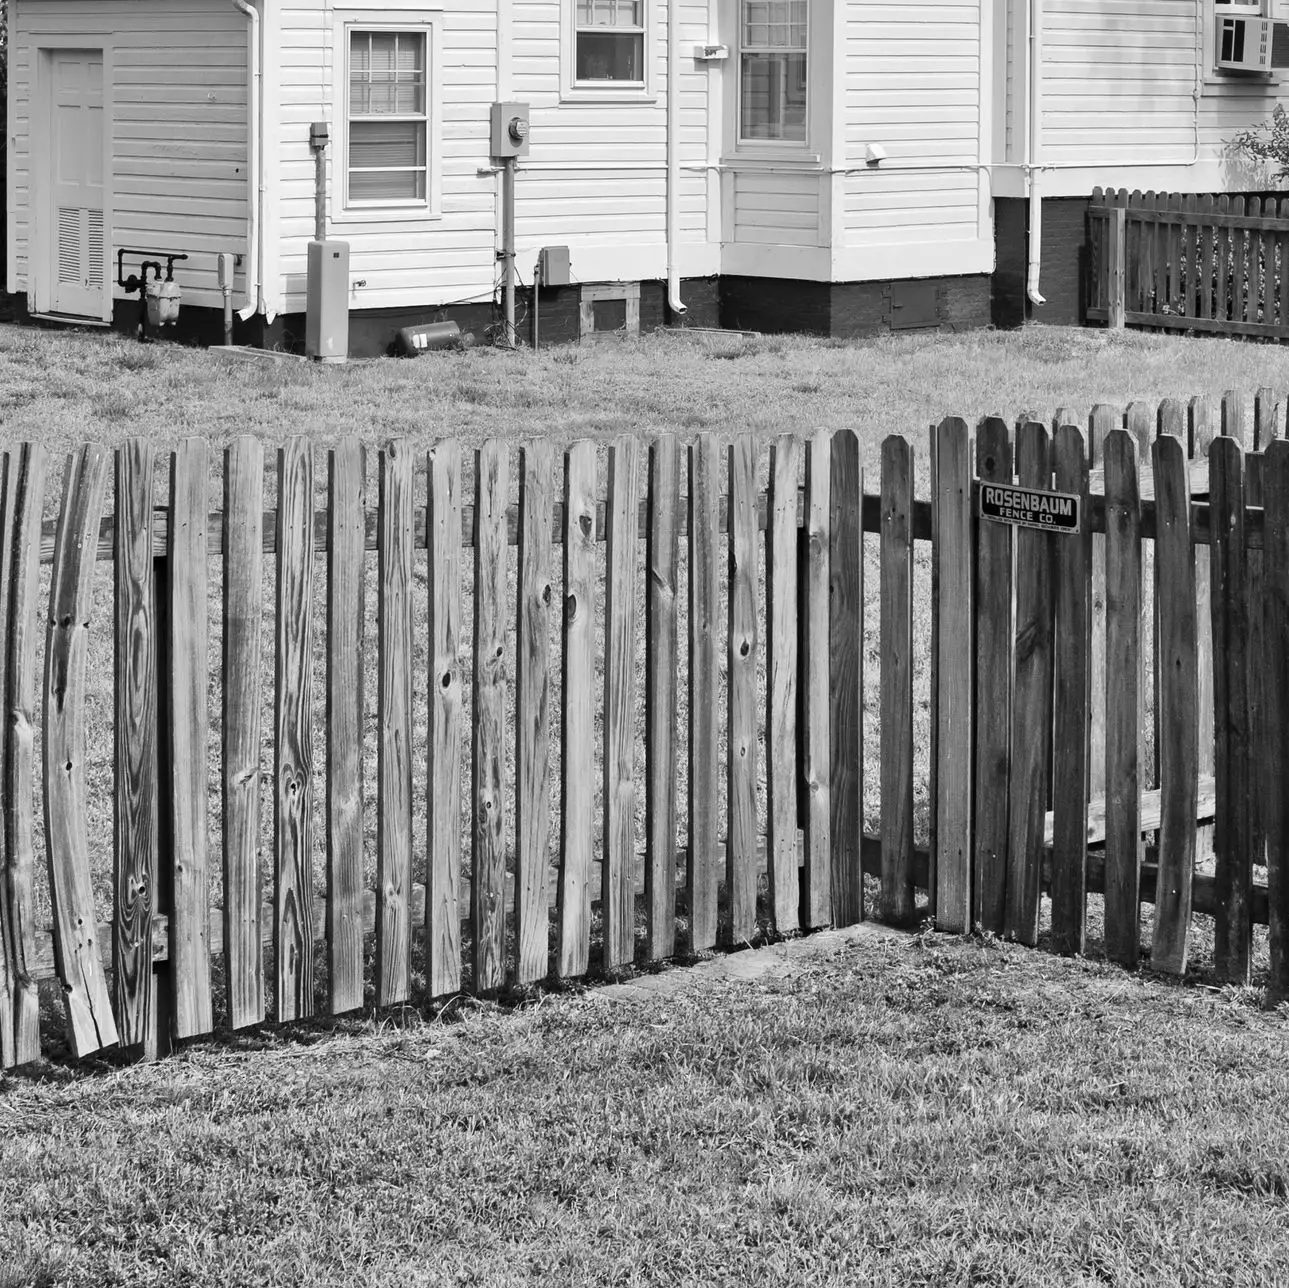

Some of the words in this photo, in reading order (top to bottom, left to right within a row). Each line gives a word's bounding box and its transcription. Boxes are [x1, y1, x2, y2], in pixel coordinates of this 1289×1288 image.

[986, 487, 1072, 516] ROSENBAUM
[999, 507, 1033, 521] FENCE
[1039, 513, 1056, 524] CO.
